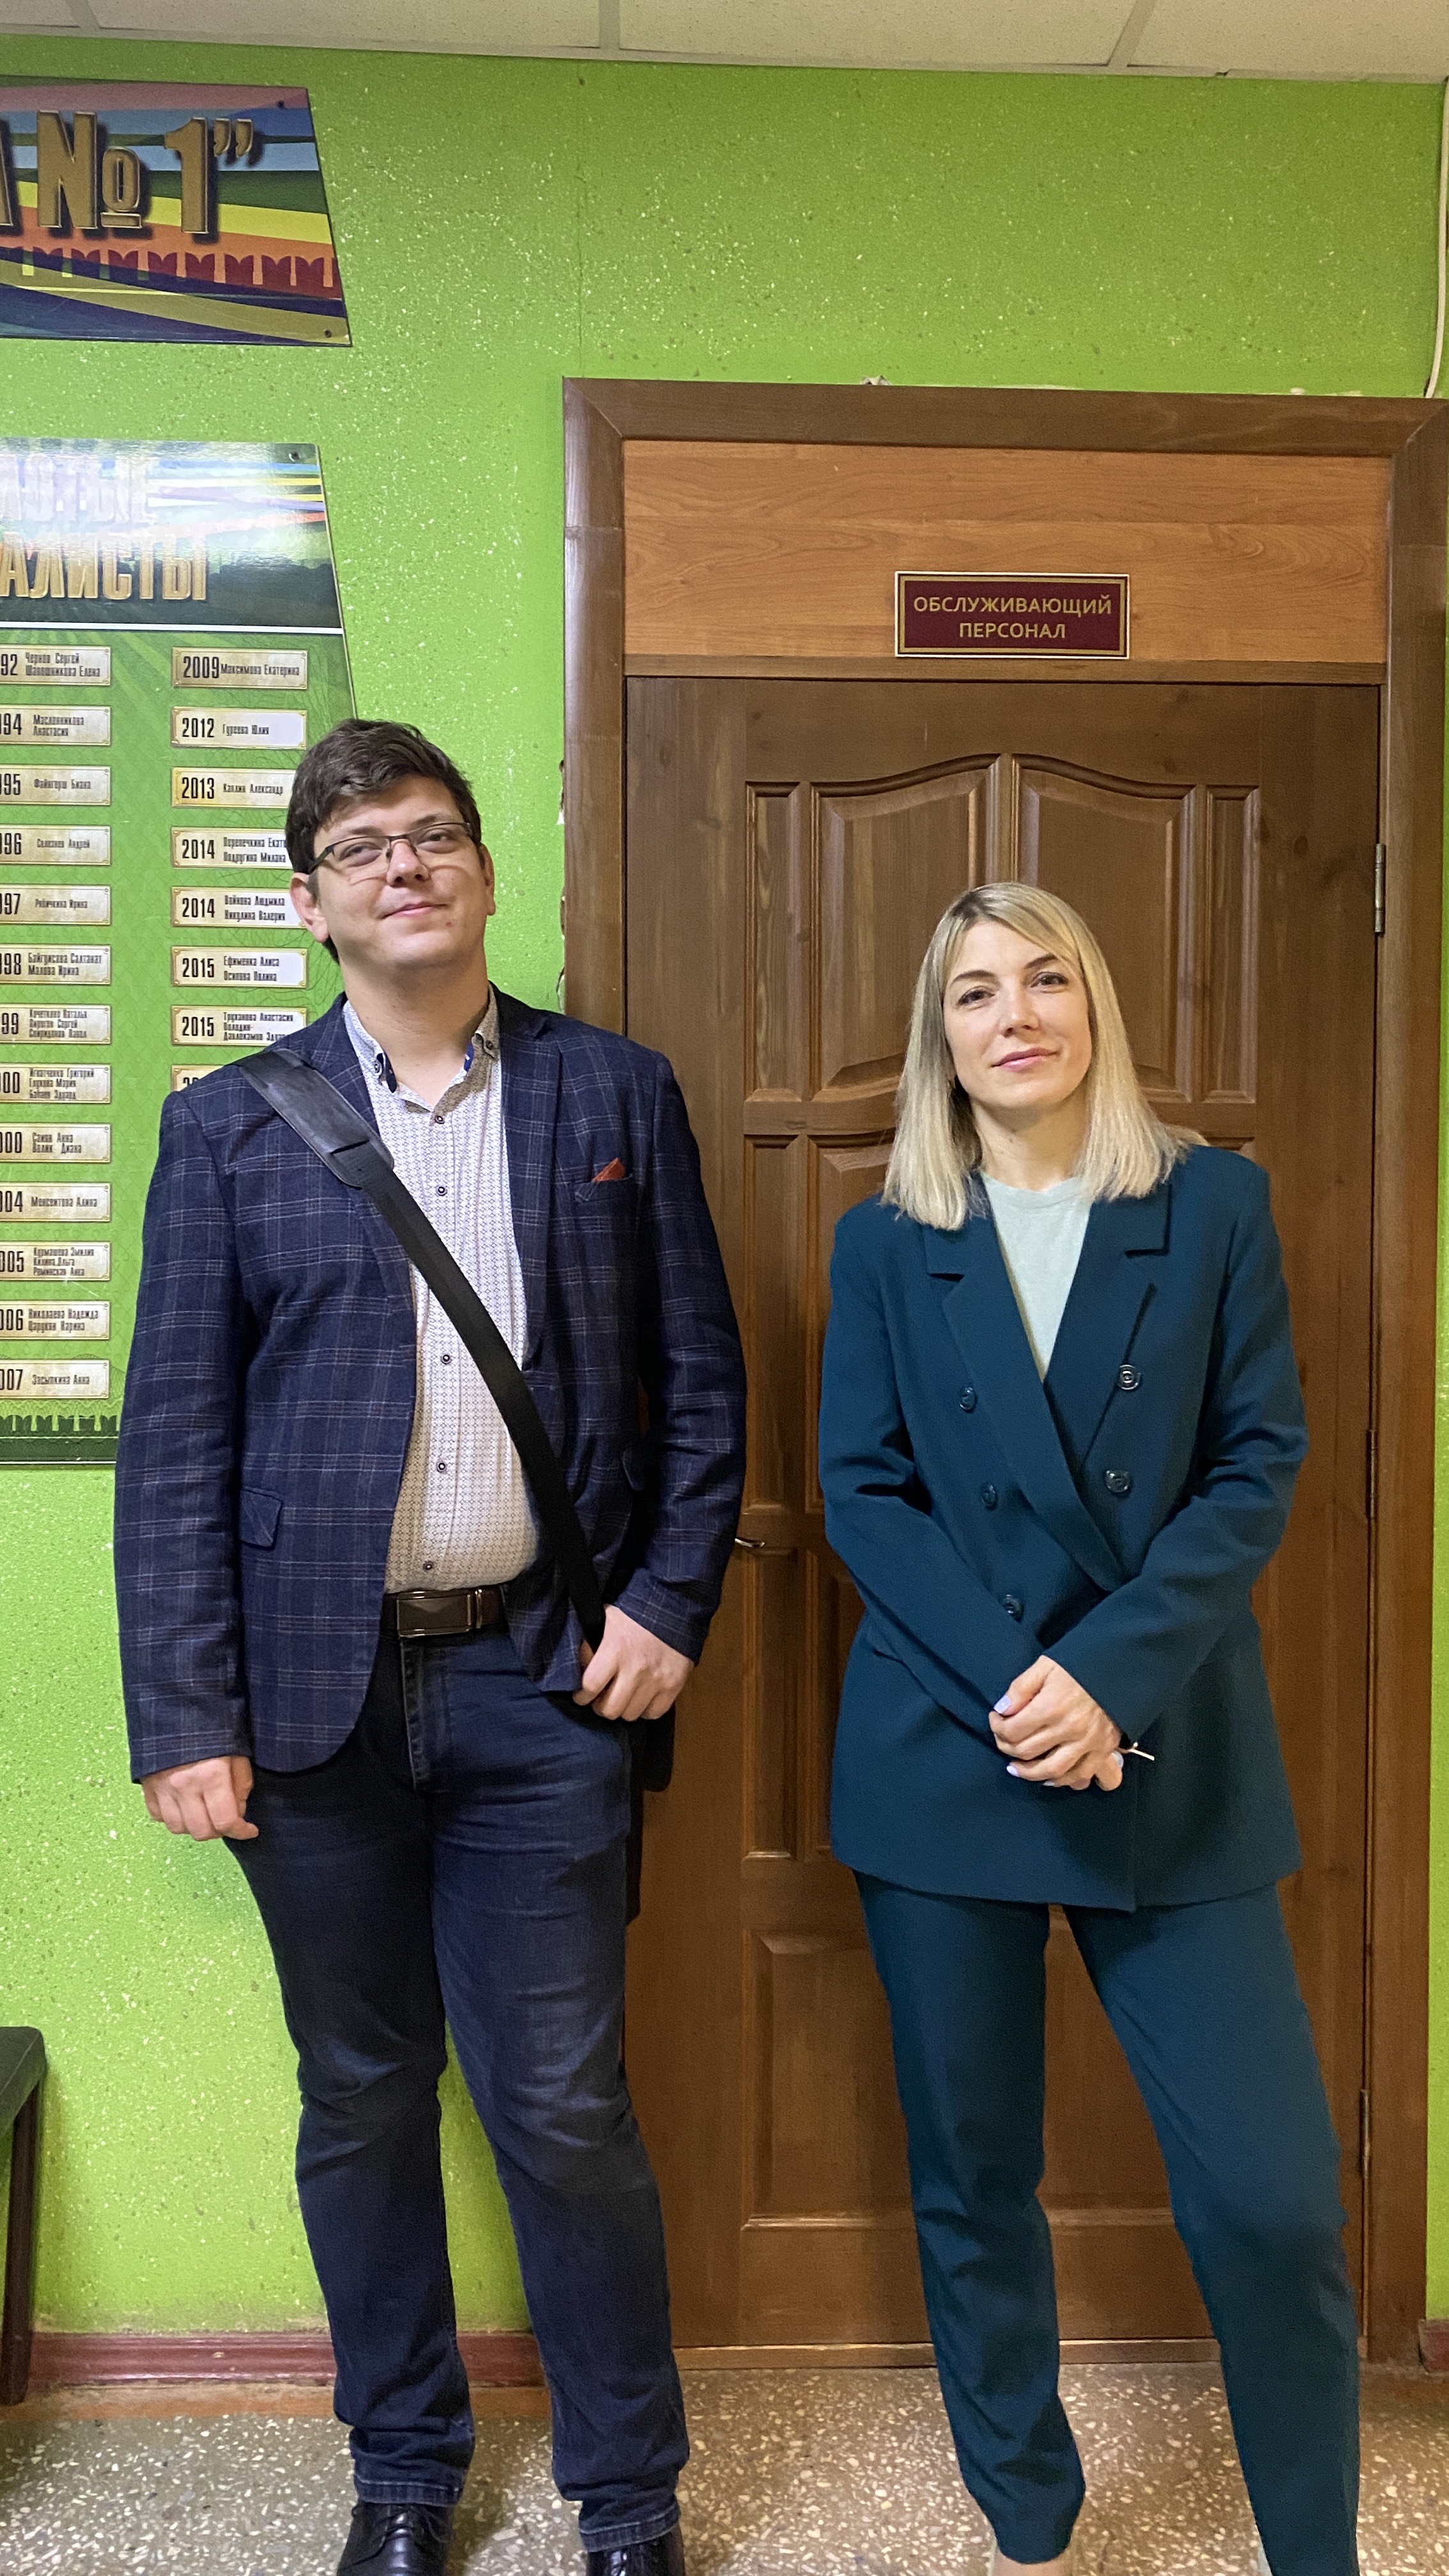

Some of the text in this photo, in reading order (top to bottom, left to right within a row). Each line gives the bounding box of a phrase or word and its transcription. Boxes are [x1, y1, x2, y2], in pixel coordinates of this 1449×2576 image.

[914, 594, 1112, 617] ОБСЛУЖИВАЮЩИЙ
[959, 622, 1066, 638] ПЕРСОНАЛ
[79, 666, 100, 677] Елена
[183, 656, 299, 678] 2009 Максимова Екатерина
[182, 717, 214, 737] 2012
[181, 778, 215, 799] 2013
[250, 784, 283, 795] Александр
[182, 839, 215, 859] 2014
[182, 898, 215, 917] 2014
[183, 958, 214, 977] 2015
[260, 957, 279, 966] Алиса
[182, 1016, 214, 1036] 2015
